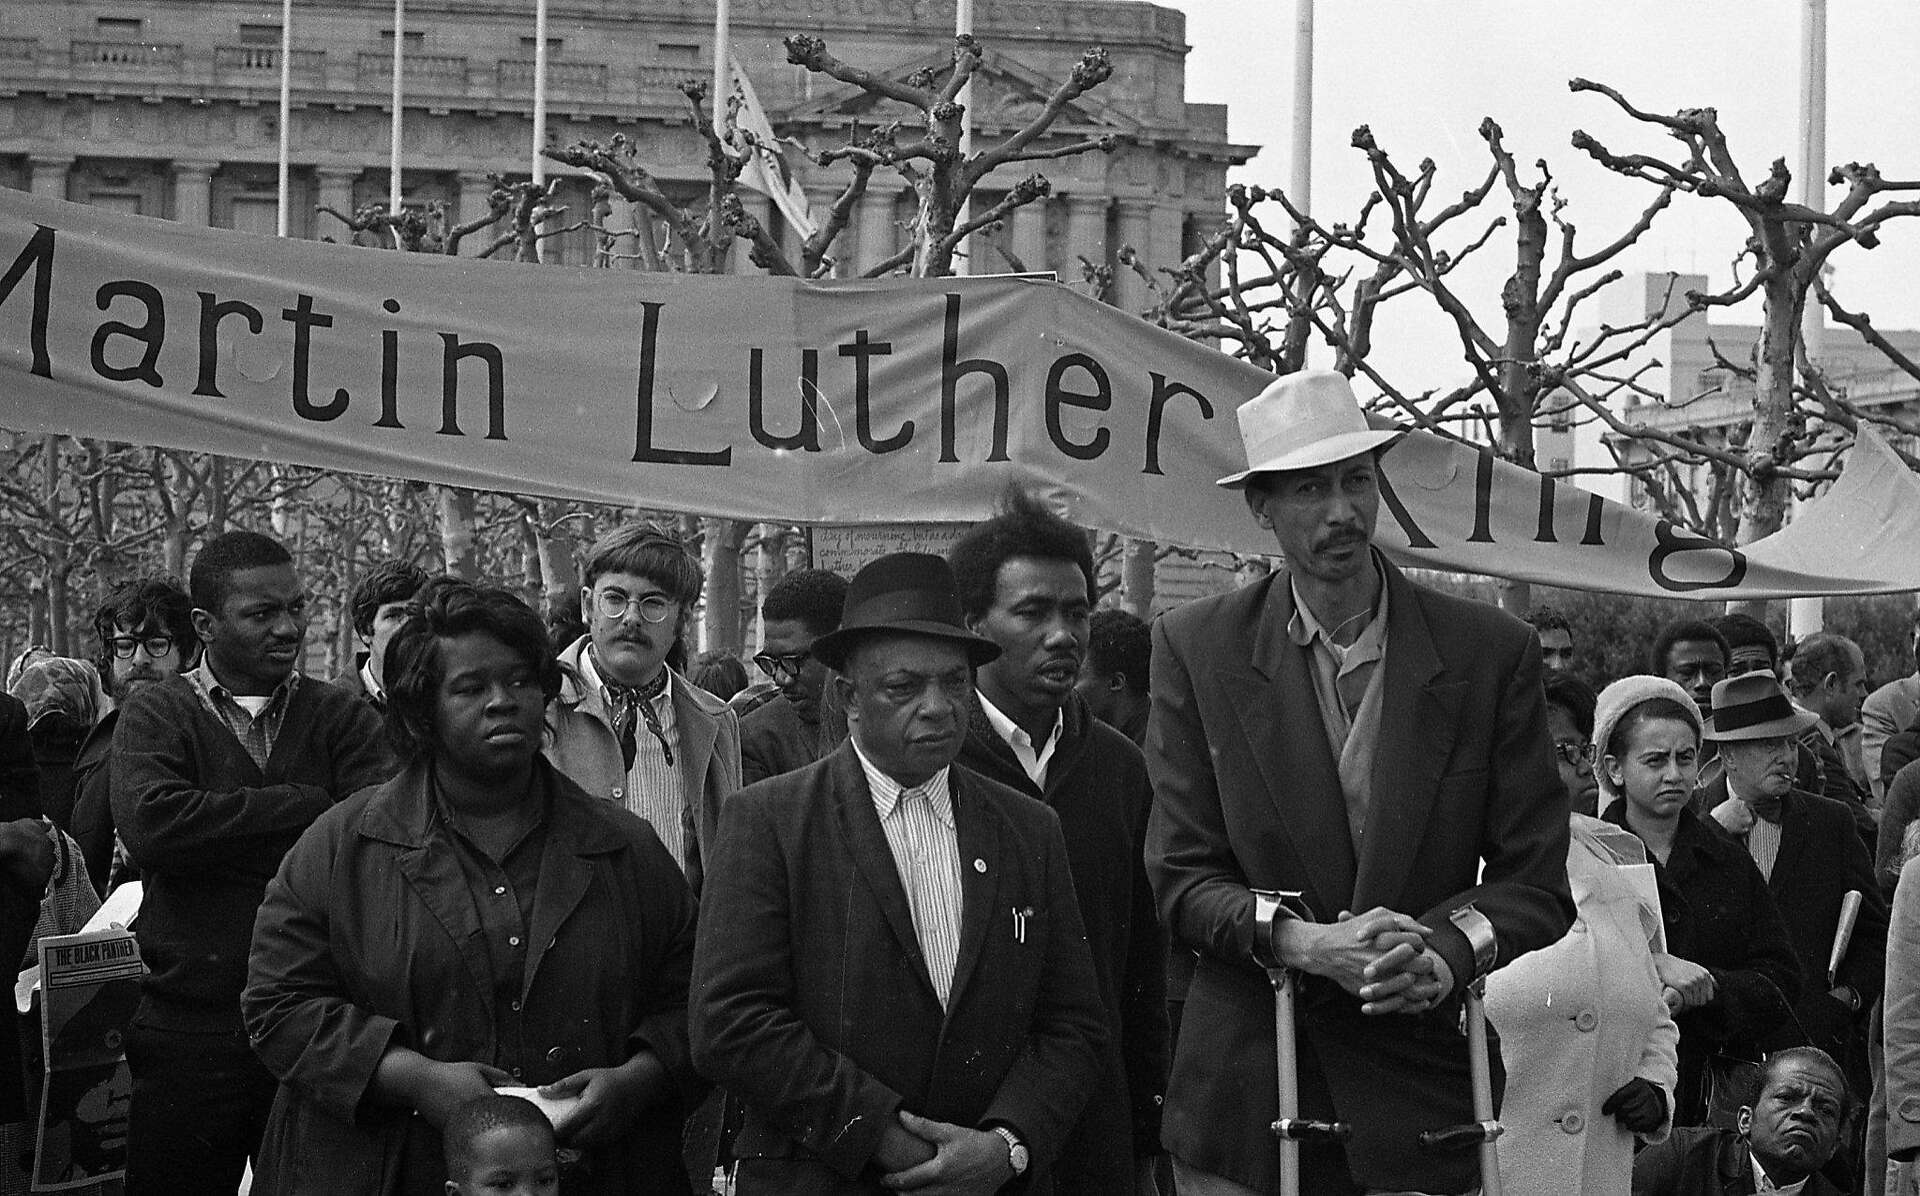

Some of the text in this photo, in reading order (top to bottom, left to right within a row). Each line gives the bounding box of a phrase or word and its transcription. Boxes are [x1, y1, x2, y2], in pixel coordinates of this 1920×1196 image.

[0, 224, 508, 441] Martin
[632, 293, 1214, 476] Luther
[56, 949, 73, 966] THE
[75, 945, 100, 964] BLACK
[102, 940, 135, 960] PANTHER
